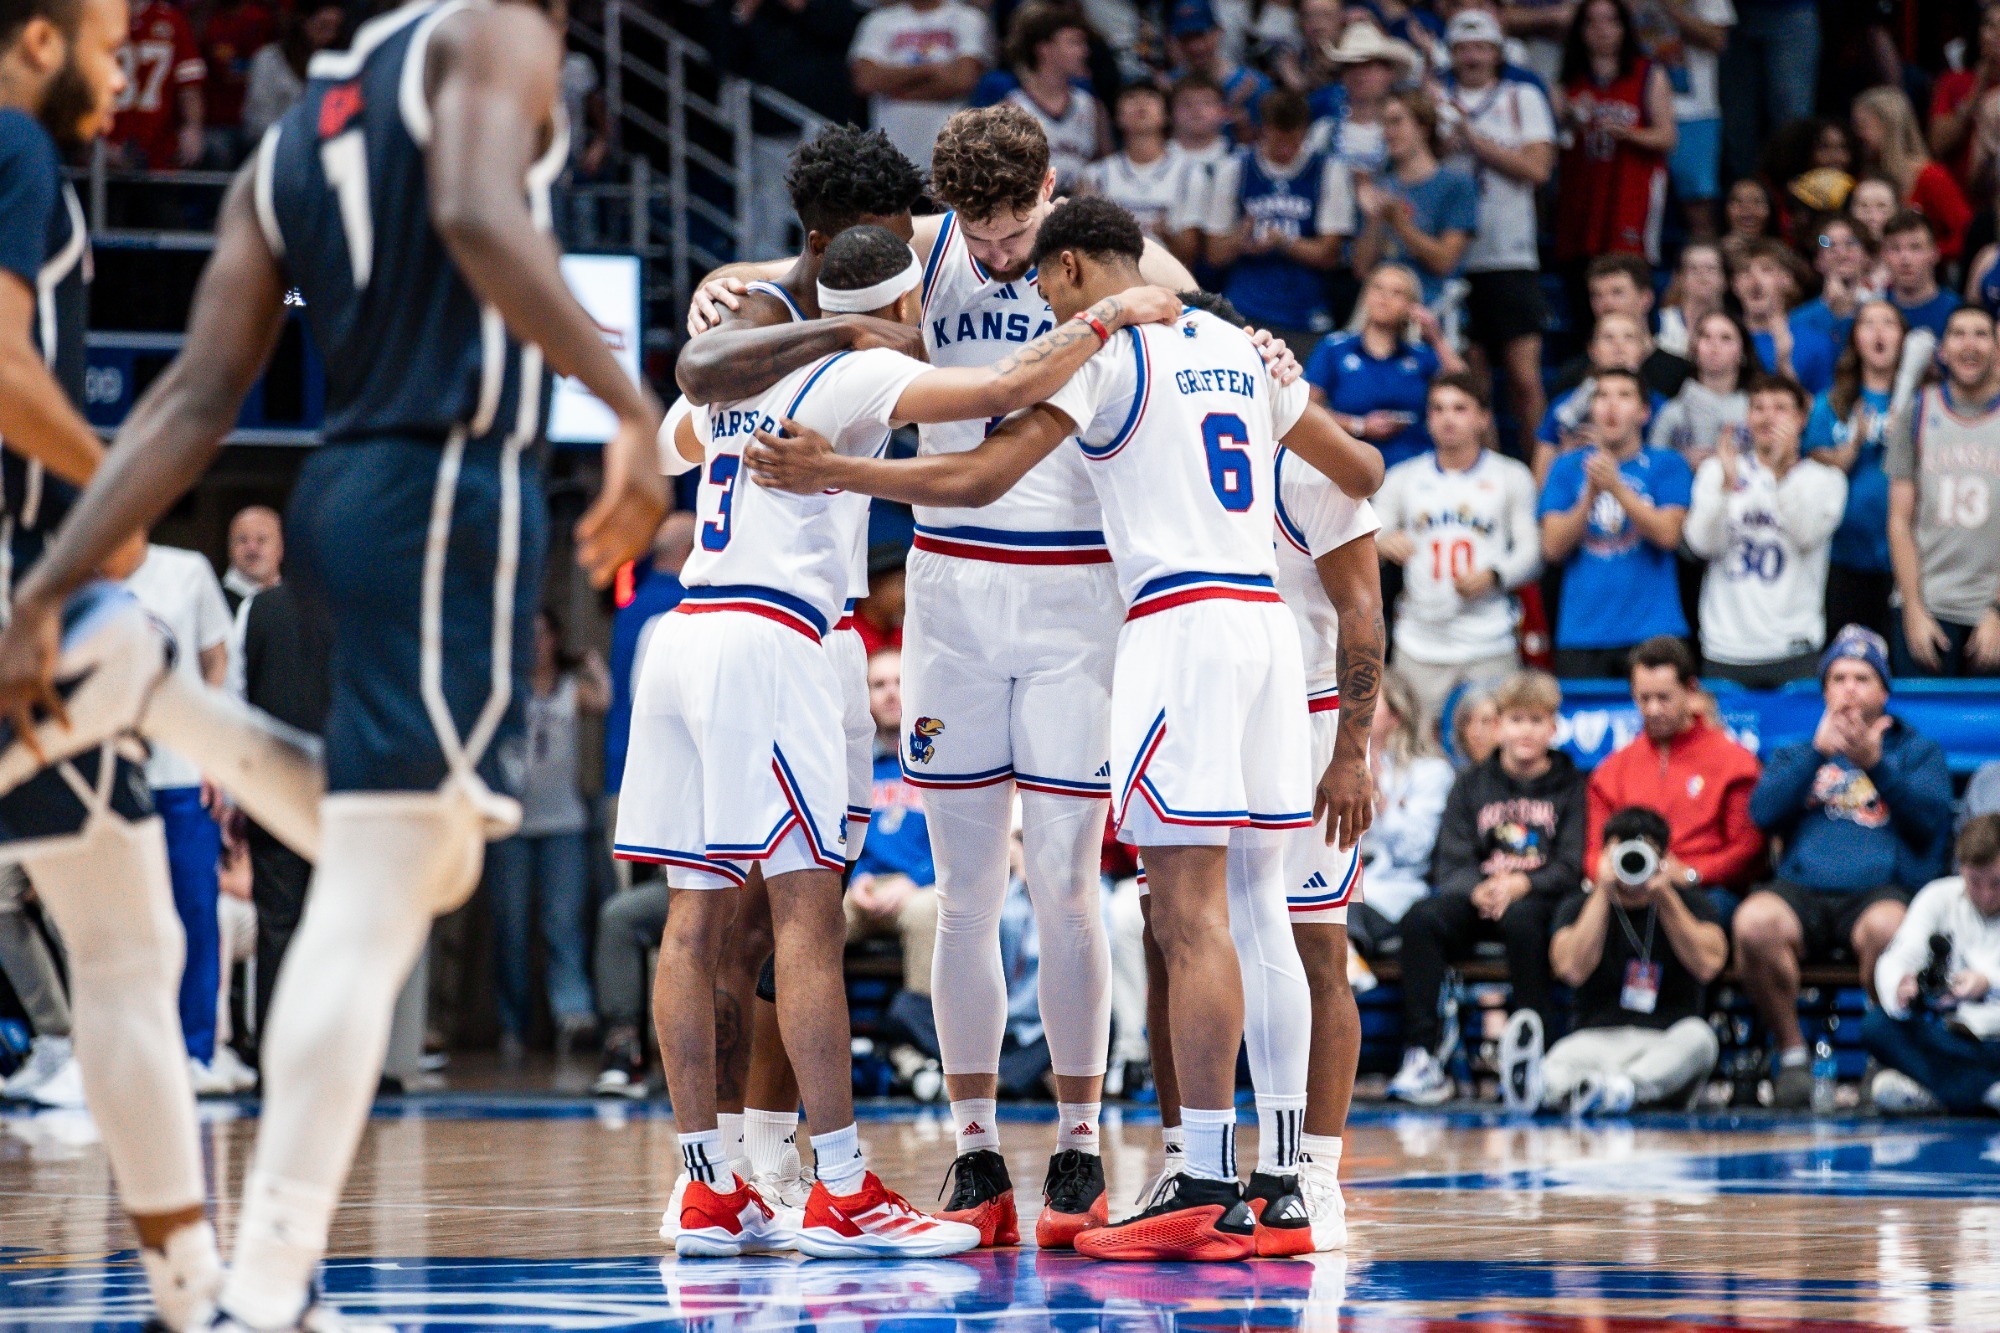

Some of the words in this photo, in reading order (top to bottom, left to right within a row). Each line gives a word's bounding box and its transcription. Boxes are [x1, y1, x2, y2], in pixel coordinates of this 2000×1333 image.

[1175, 369, 1254, 400] GRIFFEN
[1201, 412, 1255, 513] 6
[701, 453, 740, 553] 3
[1938, 475, 1989, 529] 13
[1432, 539, 1473, 582] 10
